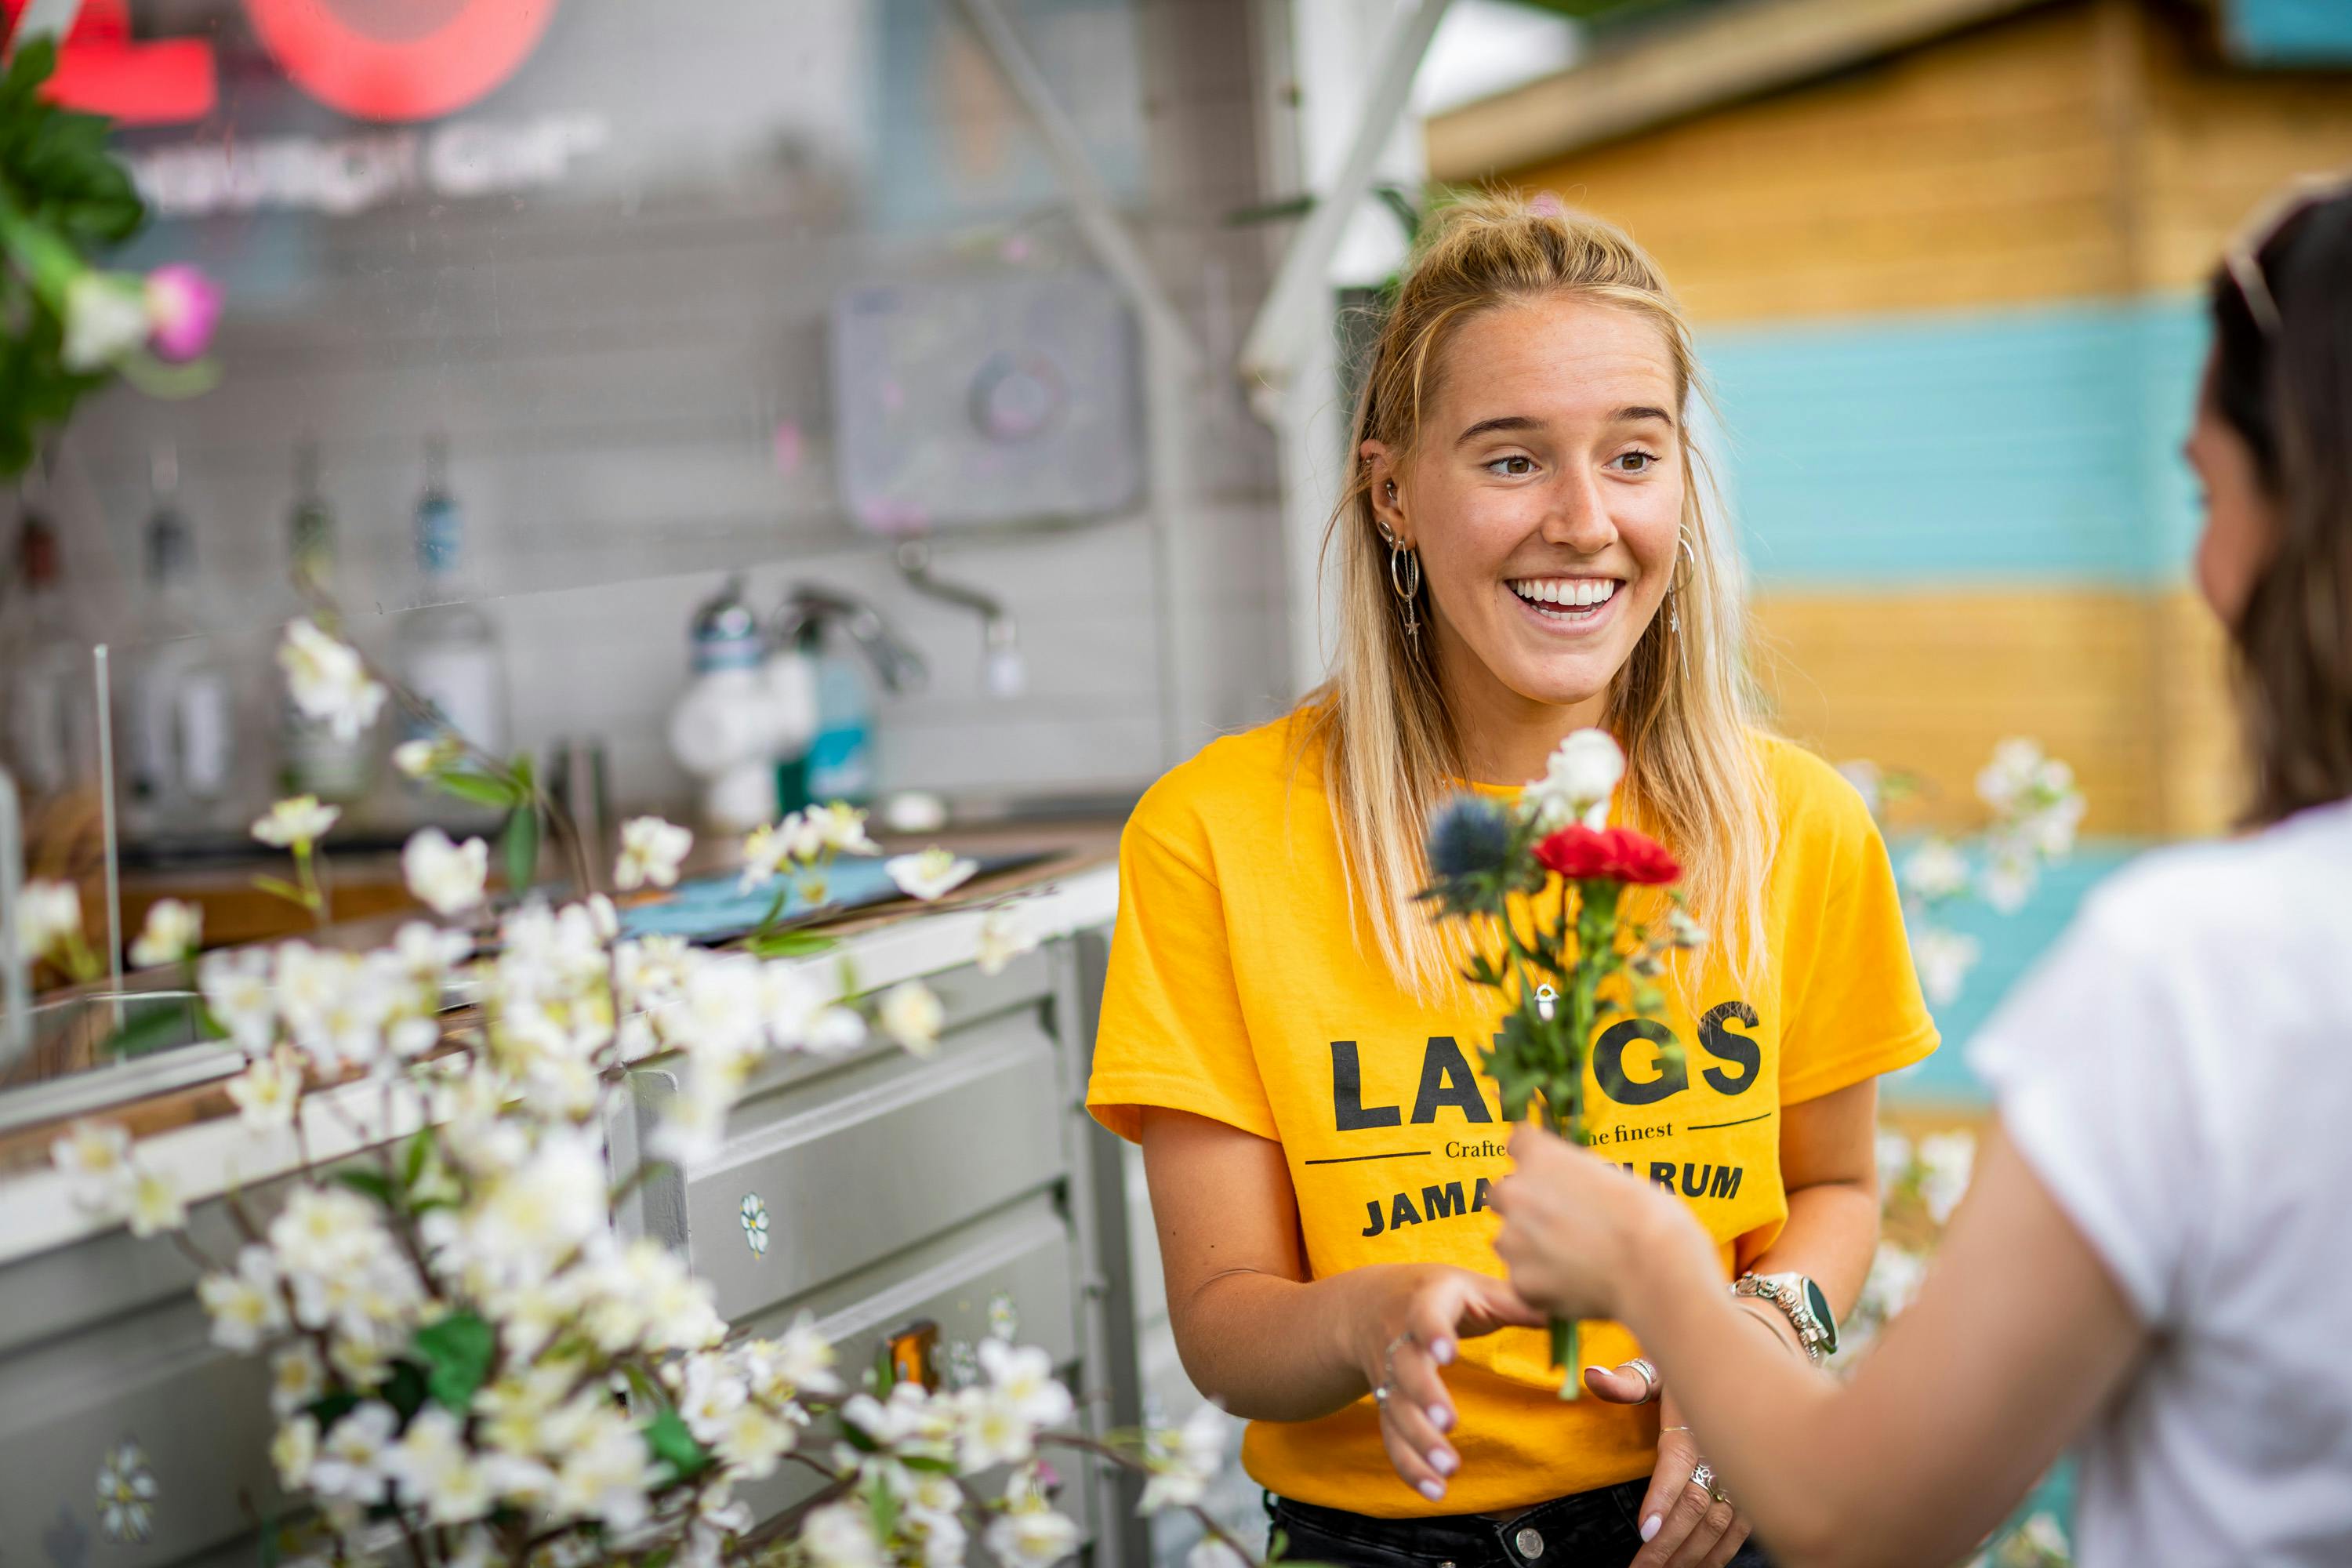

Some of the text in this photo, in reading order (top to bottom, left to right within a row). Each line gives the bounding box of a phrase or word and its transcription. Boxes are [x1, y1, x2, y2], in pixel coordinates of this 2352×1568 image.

[1330, 1001, 1762, 1131] LAGS
[1445, 1140, 1513, 1159] Crafte
[1615, 1123, 1673, 1142] finest
[1650, 1162, 1743, 1200] RUM
